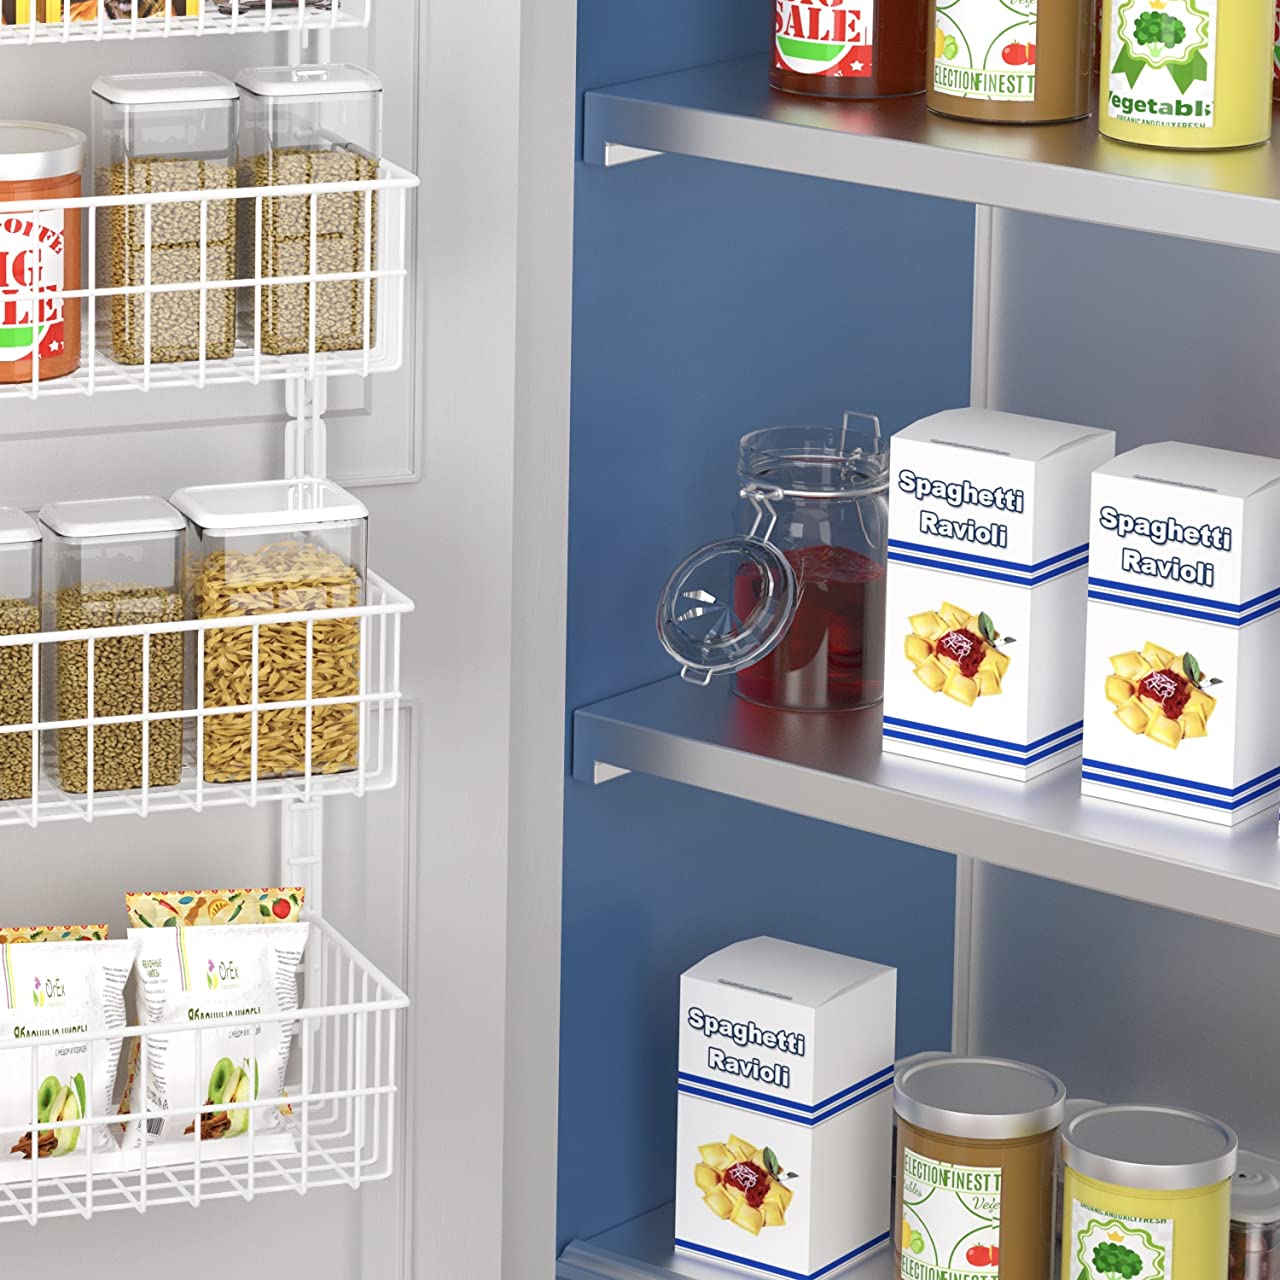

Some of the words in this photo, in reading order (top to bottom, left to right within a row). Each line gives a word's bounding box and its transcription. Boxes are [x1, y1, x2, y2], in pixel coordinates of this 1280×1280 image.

[898, 469, 1024, 513] Spaghetti
[919, 510, 1008, 548] Ravioli
[1099, 506, 1232, 551] Spaghetti
[1122, 548, 1214, 586] Ravioli
[688, 1007, 805, 1056] Spaghetti
[708, 1047, 790, 1088] Ravioli
